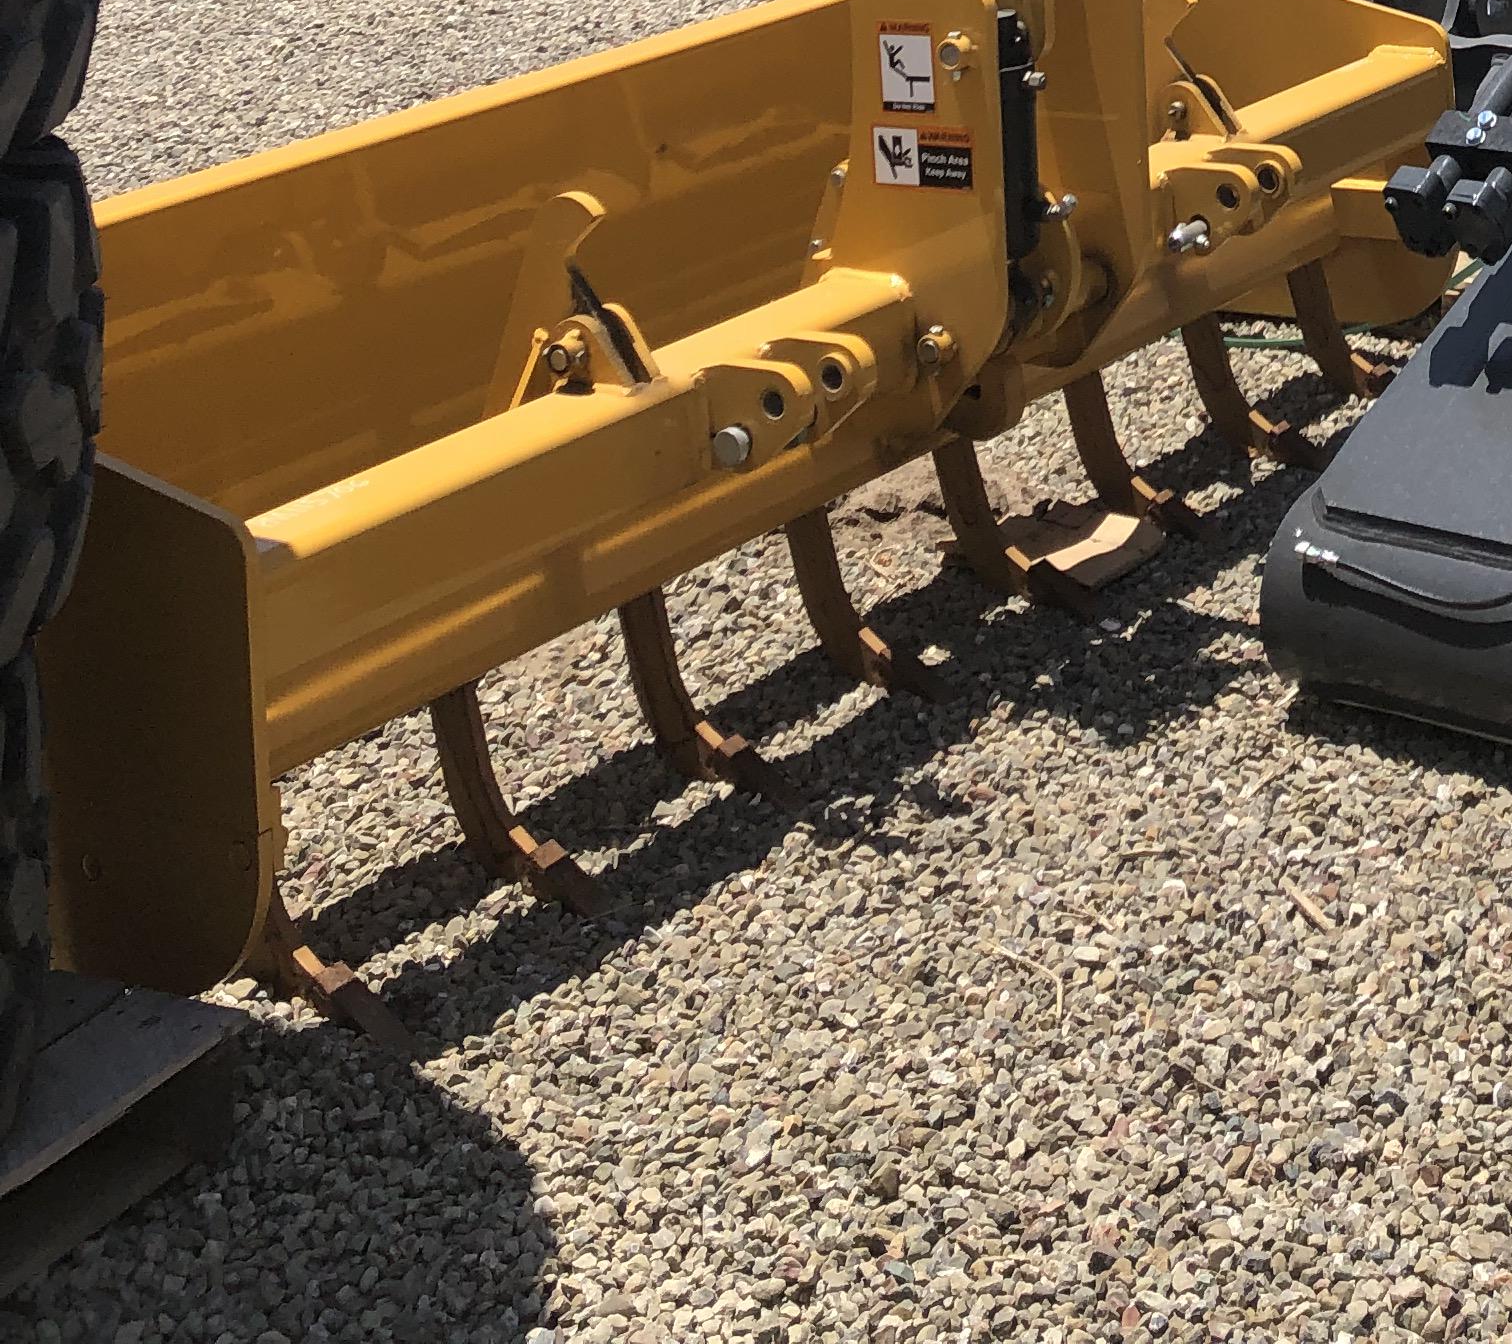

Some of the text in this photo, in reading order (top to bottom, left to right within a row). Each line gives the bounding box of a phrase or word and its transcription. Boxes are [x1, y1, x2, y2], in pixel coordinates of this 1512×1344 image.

[921, 151, 969, 166] Pinch Area
[925, 166, 967, 181] Keep Away
